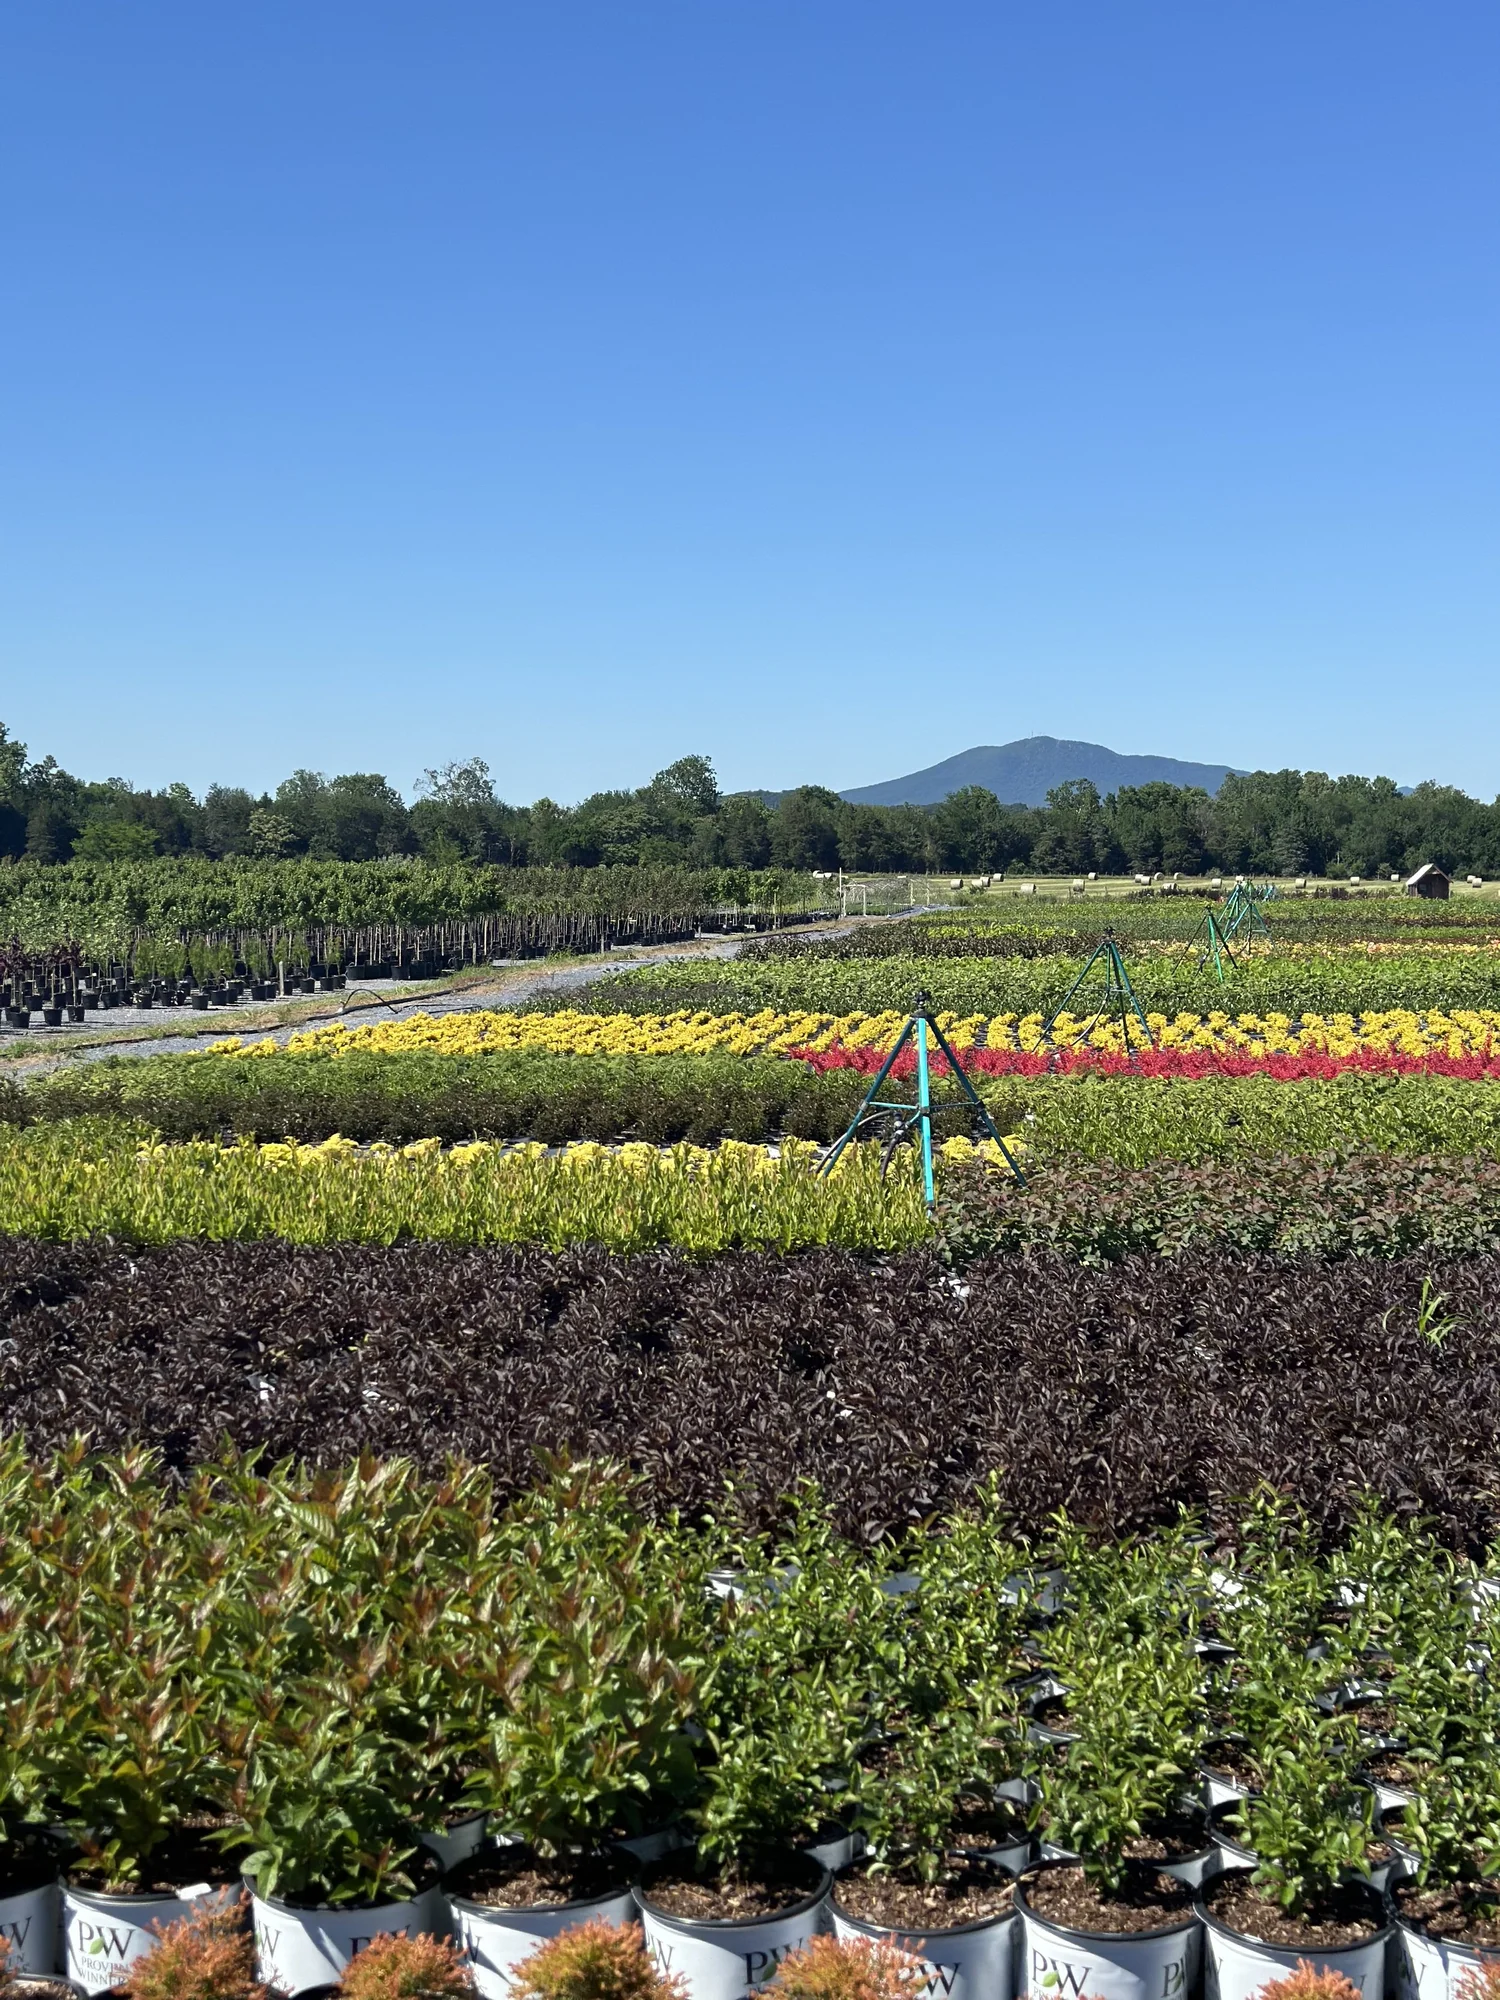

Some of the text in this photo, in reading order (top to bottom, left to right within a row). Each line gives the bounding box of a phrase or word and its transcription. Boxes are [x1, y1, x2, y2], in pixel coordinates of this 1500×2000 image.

[0, 1916, 32, 1951] W
[77, 1919, 136, 1960] PW
[257, 1919, 282, 1960] W
[648, 1933, 674, 1972] W
[80, 1967, 128, 1987] WINNER
[1032, 1947, 1093, 1998] PW
[1160, 1957, 1186, 1998] P
